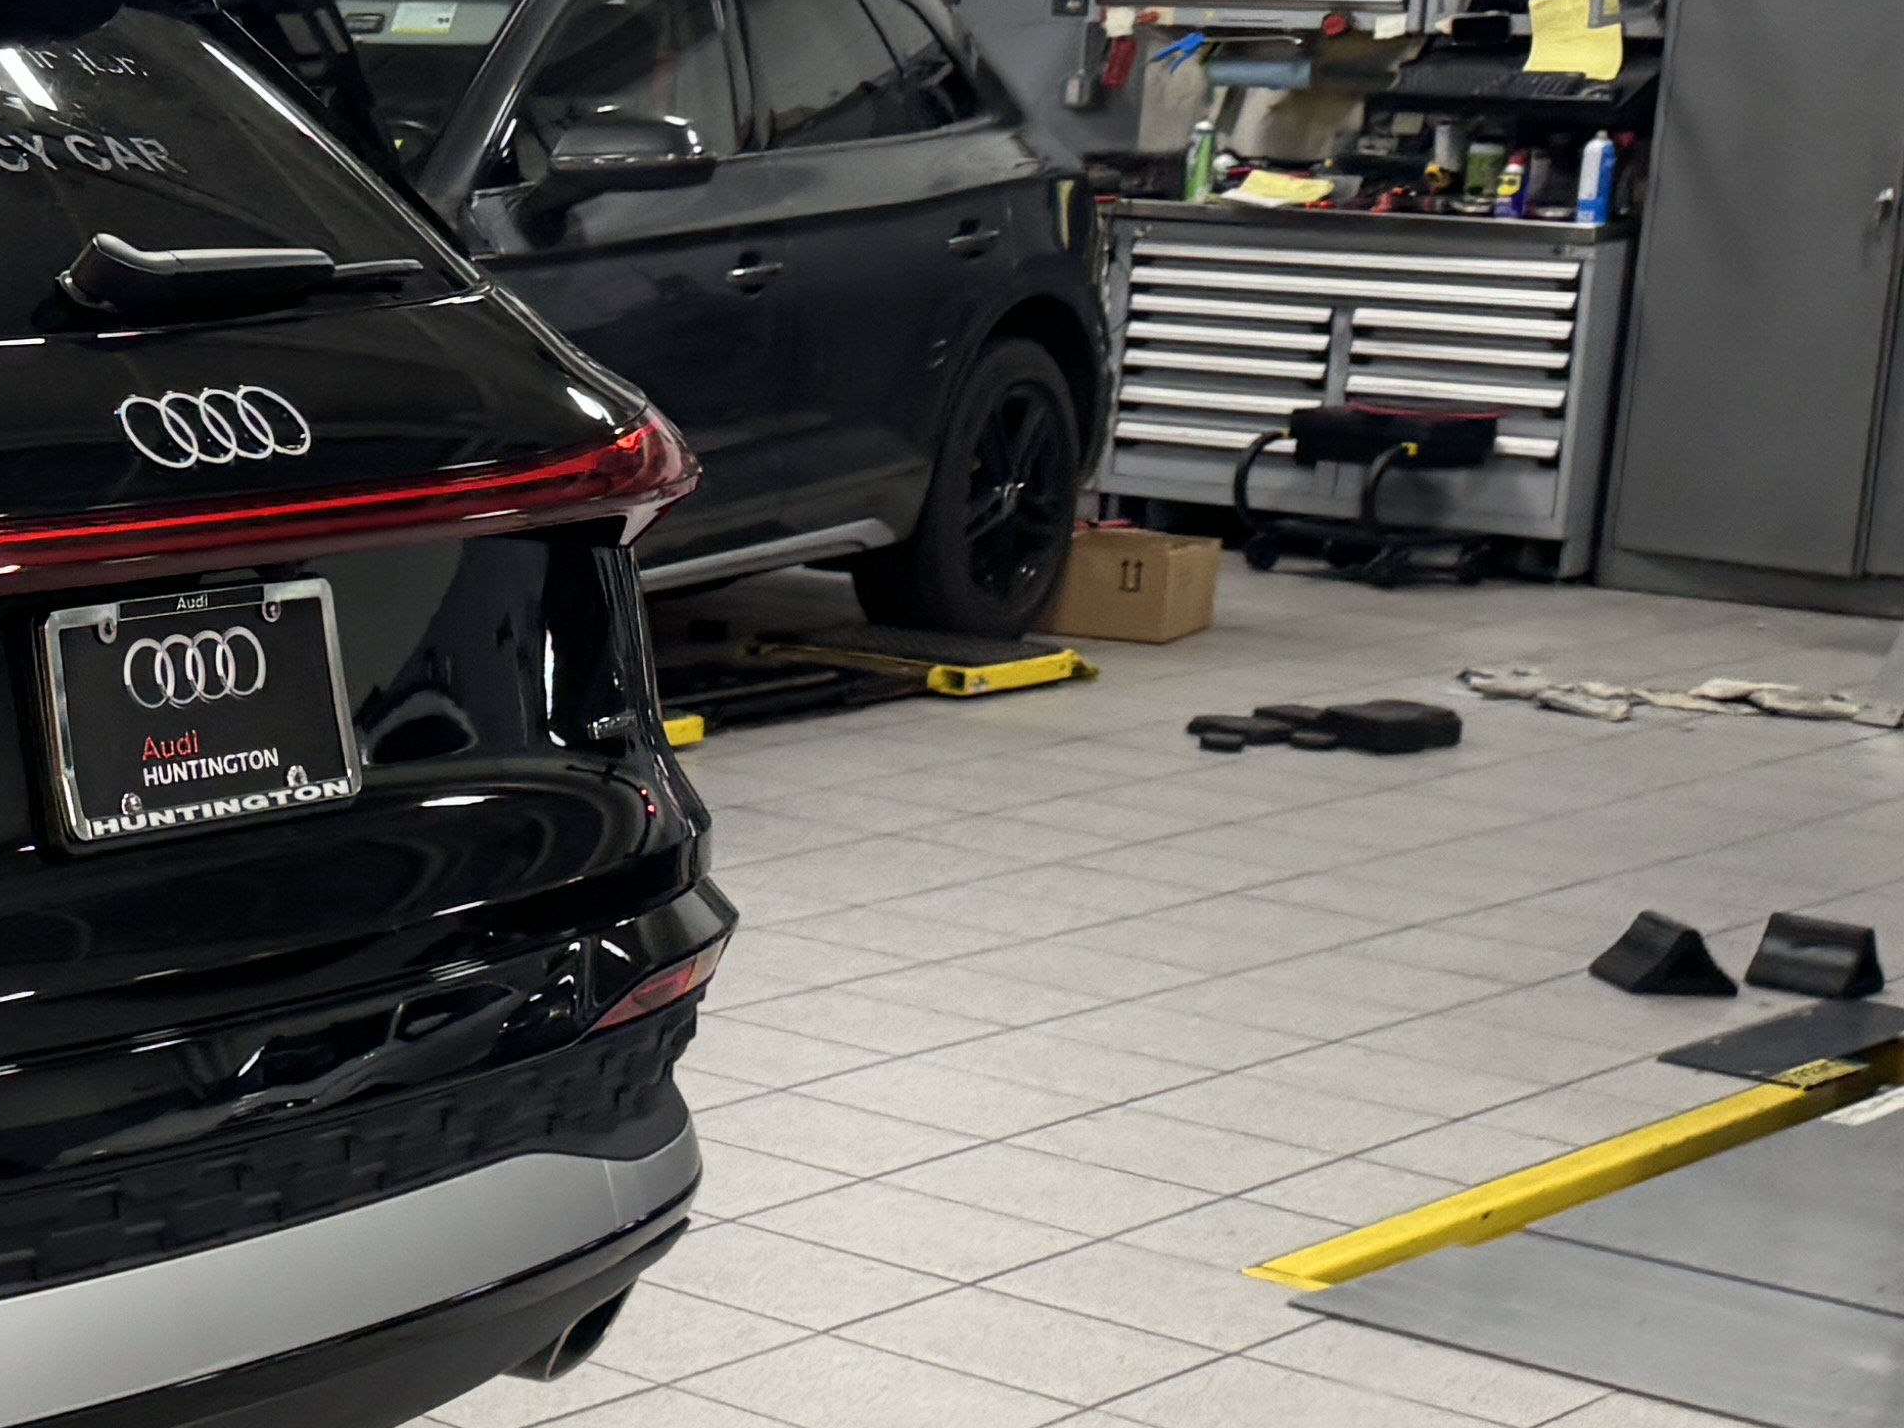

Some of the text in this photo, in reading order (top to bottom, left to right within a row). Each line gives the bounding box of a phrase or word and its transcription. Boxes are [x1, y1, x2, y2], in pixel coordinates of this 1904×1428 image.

[65, 134, 188, 174] CAR
[176, 594, 208, 611] Audi
[142, 729, 200, 761] Audi
[143, 747, 279, 788] HUNTINGTON
[93, 778, 350, 836] HUNTINGTON
